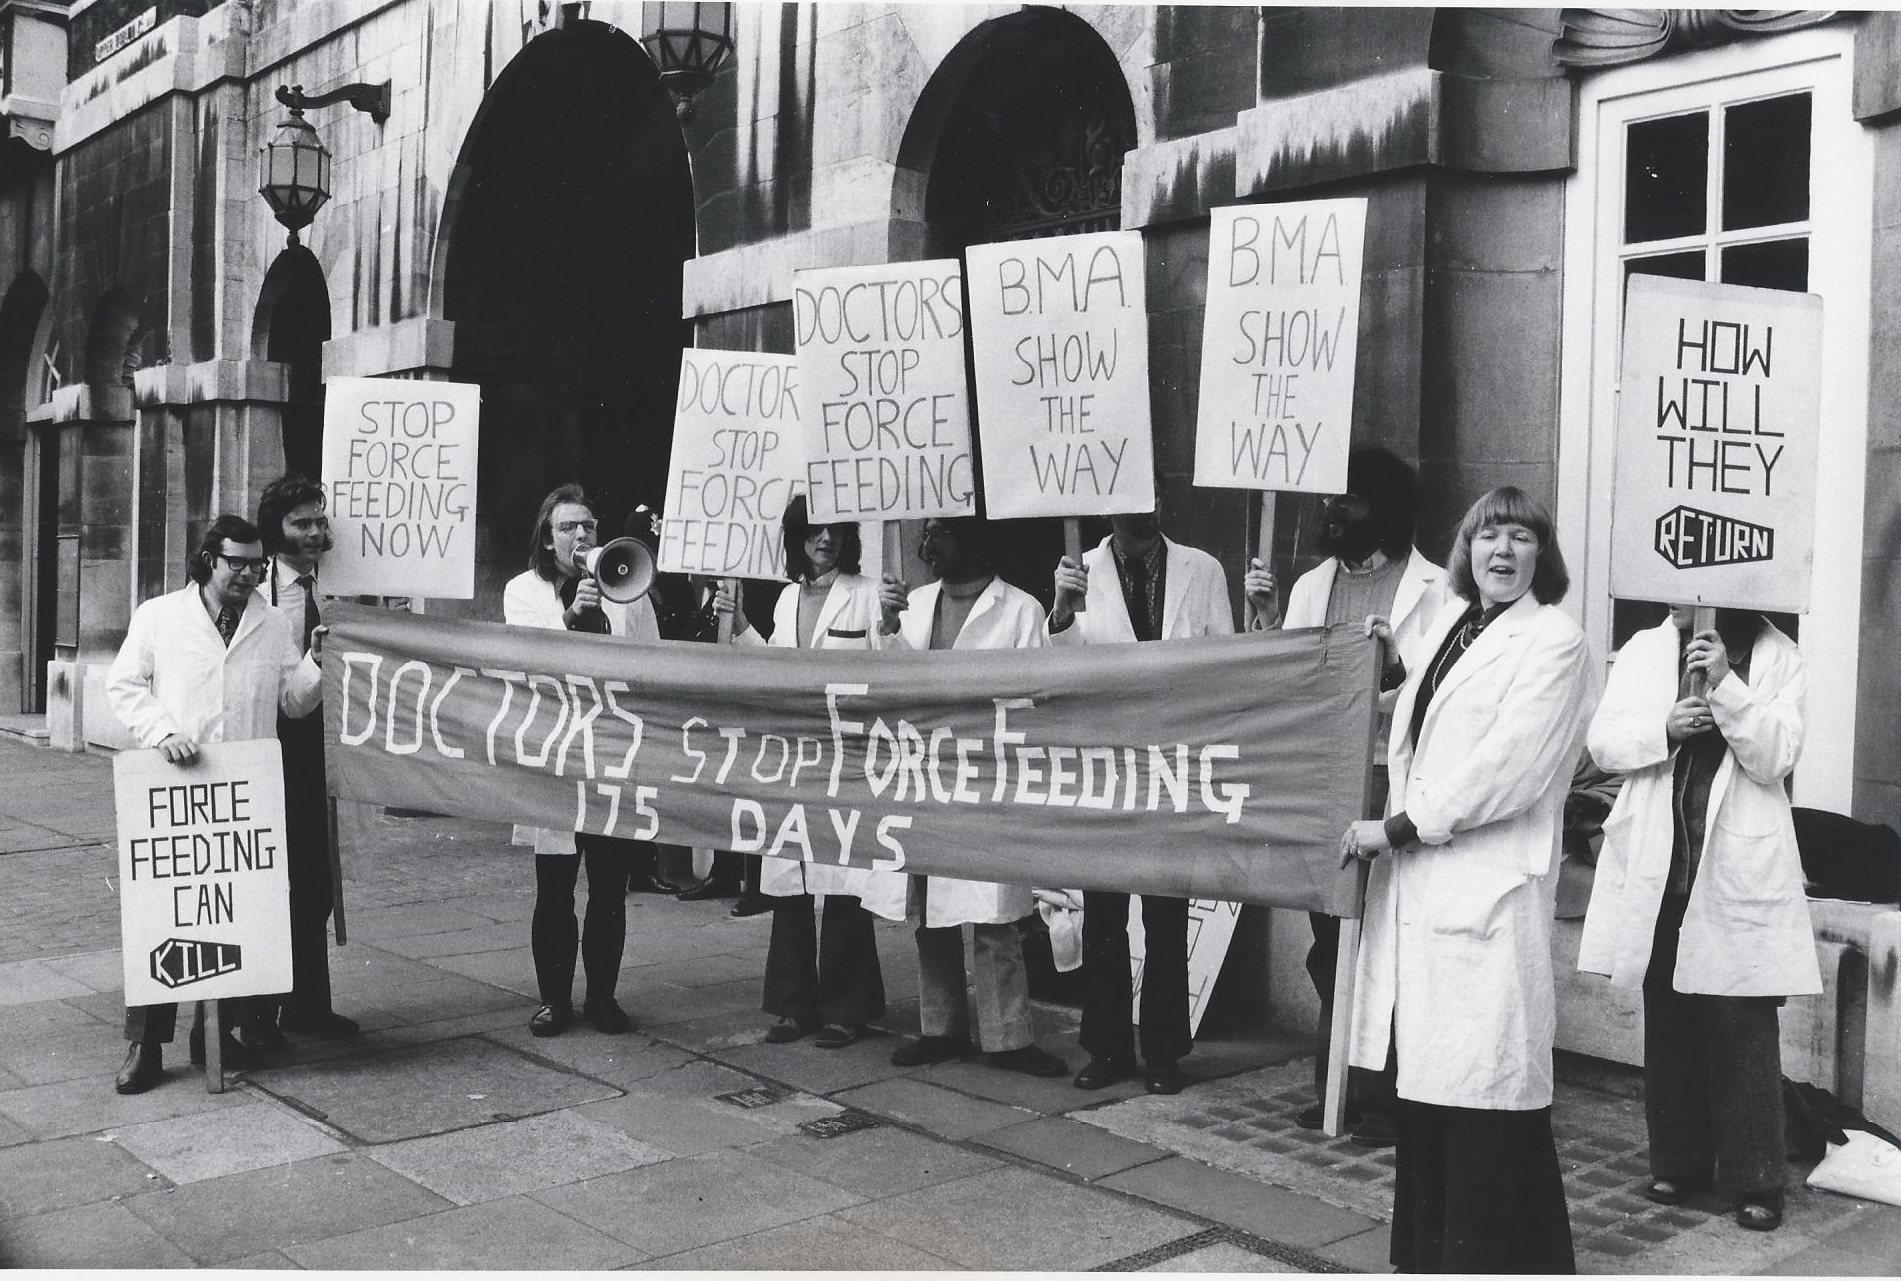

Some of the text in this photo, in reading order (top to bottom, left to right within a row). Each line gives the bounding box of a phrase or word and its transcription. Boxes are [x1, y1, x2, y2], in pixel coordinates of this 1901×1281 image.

[795, 275, 963, 346] DOCTORS
[1233, 306, 1346, 372] SHOW
[840, 349, 920, 397] STOP
[1012, 328, 1117, 388] SHOW
[1676, 318, 1772, 378] HOW
[357, 400, 456, 439] STOP
[822, 394, 955, 452] FORCE
[1040, 395, 1095, 434] THE
[1251, 373, 1299, 419] THE
[1657, 376, 1784, 437] WILL
[347, 439, 461, 480] FORCE
[708, 429, 779, 471] STOP
[1029, 438, 1128, 495] WAY
[1231, 421, 1322, 485] WAY
[1657, 435, 1784, 496] THEY
[332, 480, 470, 522] FEEDING
[807, 454, 974, 514] FEEDING
[361, 522, 454, 558] NOW
[662, 519, 787, 576] FEEDIN
[1658, 508, 1770, 567] RETURN
[340, 652, 1250, 824] DOCTORS STOP FORCE FEEDING
[149, 781, 250, 828] FORCE
[575, 780, 913, 872] 175 DAYS
[131, 828, 276, 880] FEEDING
[174, 882, 233, 927] CAN
[155, 940, 236, 986] KILL
